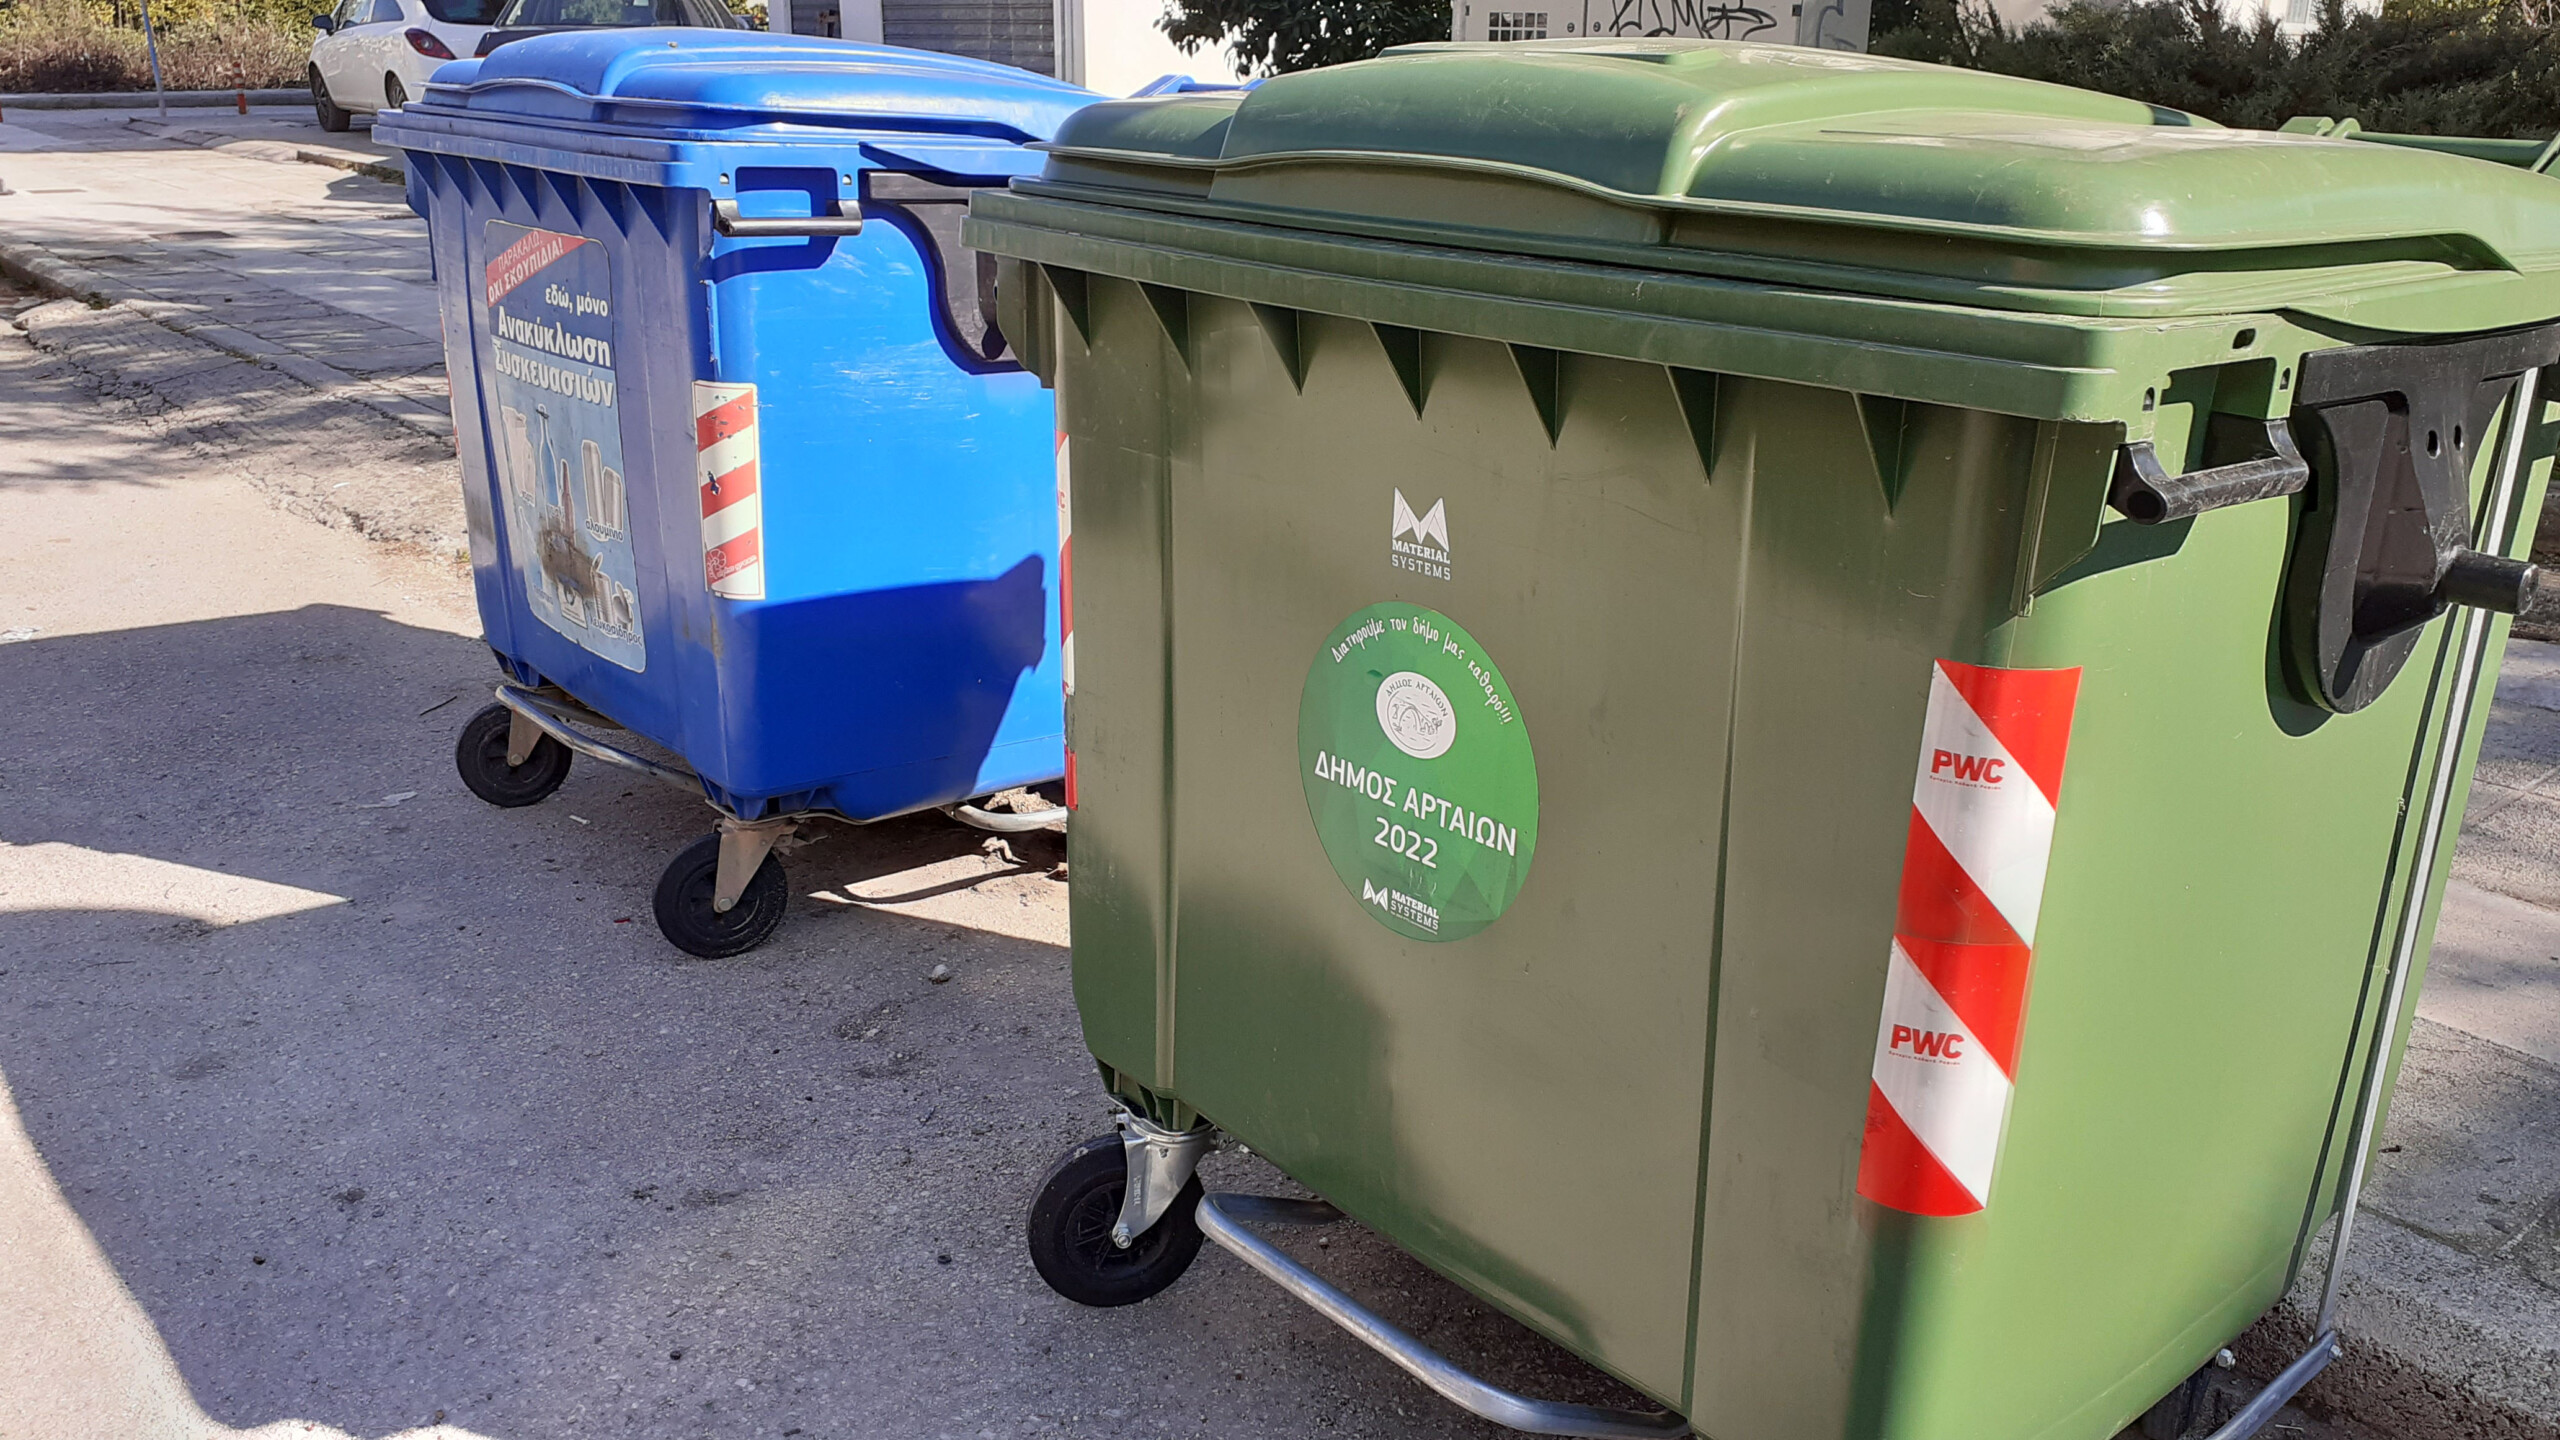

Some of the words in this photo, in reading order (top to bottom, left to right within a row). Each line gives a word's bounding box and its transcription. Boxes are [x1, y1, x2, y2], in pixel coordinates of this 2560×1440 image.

[488, 278, 504, 302] ΟΧΙ
[504, 236, 564, 291] ΣΚΟΥΠΙΔΙΑ!
[545, 283, 573, 314] εδώ,
[576, 291, 608, 317] μόνο
[498, 306, 611, 367] Ανακύκλωση
[492, 338, 613, 407] Συσκευασιών
[1392, 539, 1451, 565] MATERIAL
[1392, 554, 1451, 581] SYSTEMS
[1330, 617, 1386, 663] Διατηρούμε
[1389, 617, 1408, 631] τον
[1412, 616, 1439, 644] δήμο
[1442, 632, 1465, 660] μας
[1467, 659, 1514, 725] καθαρό!!!
[1385, 678, 1413, 697] ΔΗΜΟΣ
[1415, 680, 1449, 717] ΑΡΤΑΙΩΝ
[1931, 748, 2006, 784] PWC
[1314, 750, 1397, 808] ΔΗΜΟΣ
[1402, 787, 1517, 857] ΑΡΤΑΙΩΝ
[1374, 816, 1439, 869] 2022
[1390, 900, 1439, 930] SYSTEMS
[1391, 889, 1440, 920] MATERIAL
[1890, 1023, 1965, 1059] PWC
